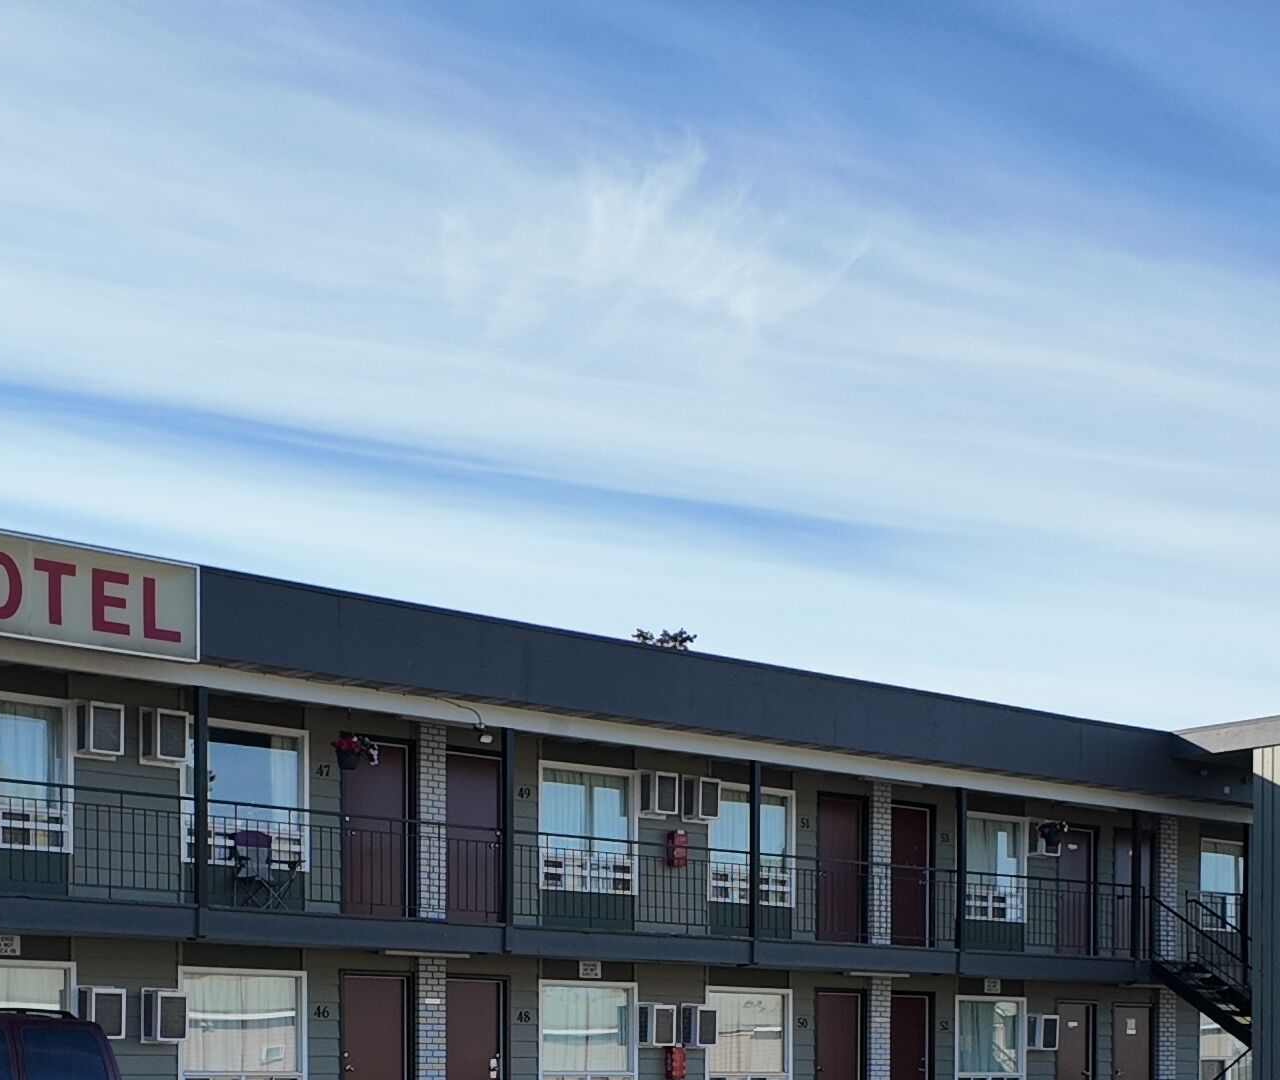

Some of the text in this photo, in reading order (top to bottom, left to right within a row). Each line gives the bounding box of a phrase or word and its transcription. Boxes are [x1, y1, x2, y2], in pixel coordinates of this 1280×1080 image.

[316, 764, 330, 777] 47
[517, 787, 531, 799] 49
[800, 817, 810, 829] 51
[314, 1005, 330, 1019] 46
[517, 1011, 531, 1023] 48
[796, 1017, 808, 1029] 50
